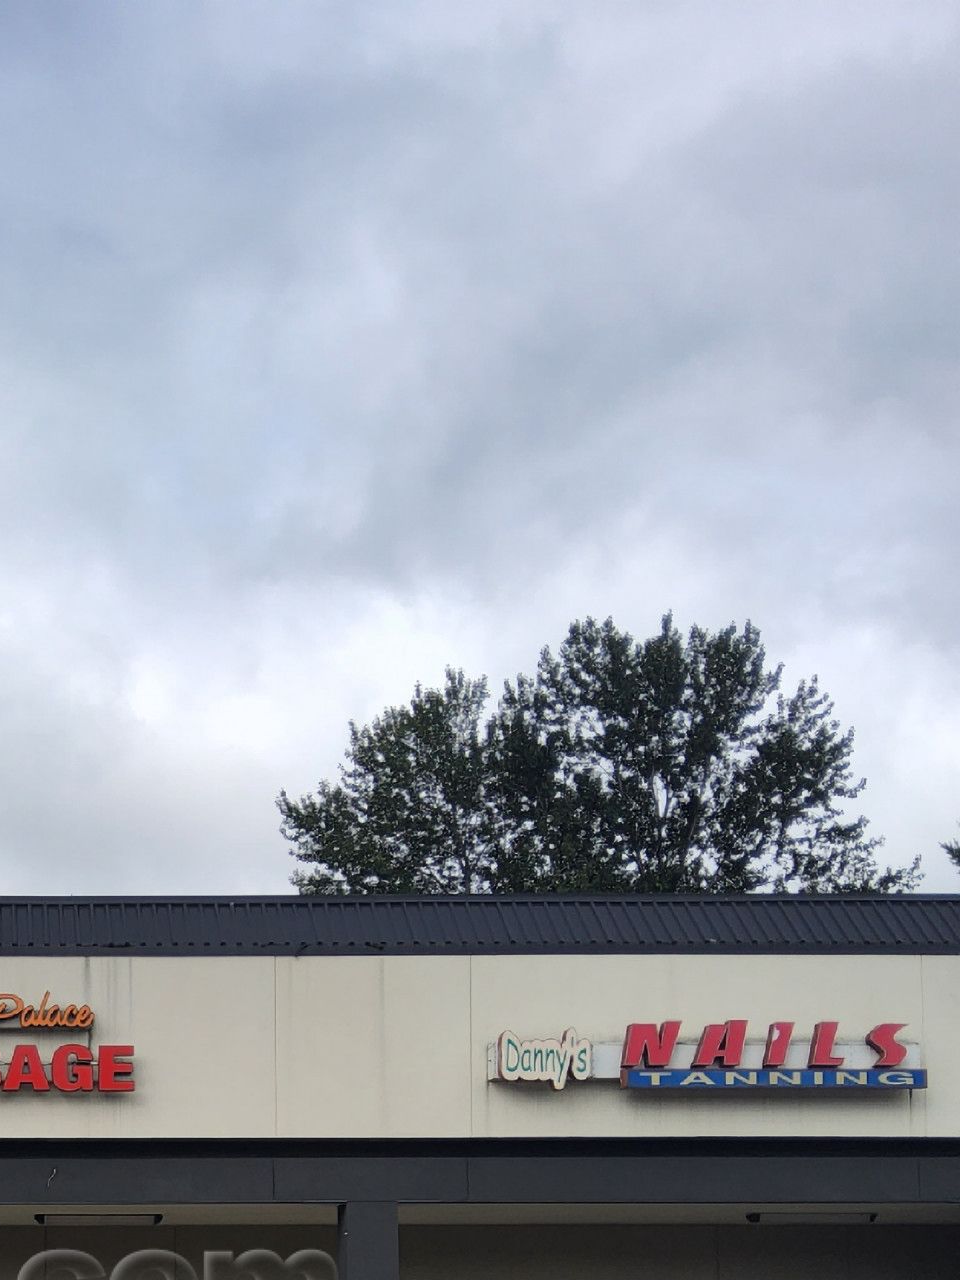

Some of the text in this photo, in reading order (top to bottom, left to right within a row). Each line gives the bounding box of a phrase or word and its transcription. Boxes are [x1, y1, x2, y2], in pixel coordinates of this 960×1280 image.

[505, 1020, 909, 1082] Danny's NAILS
[639, 1071, 916, 1086] TANNING
